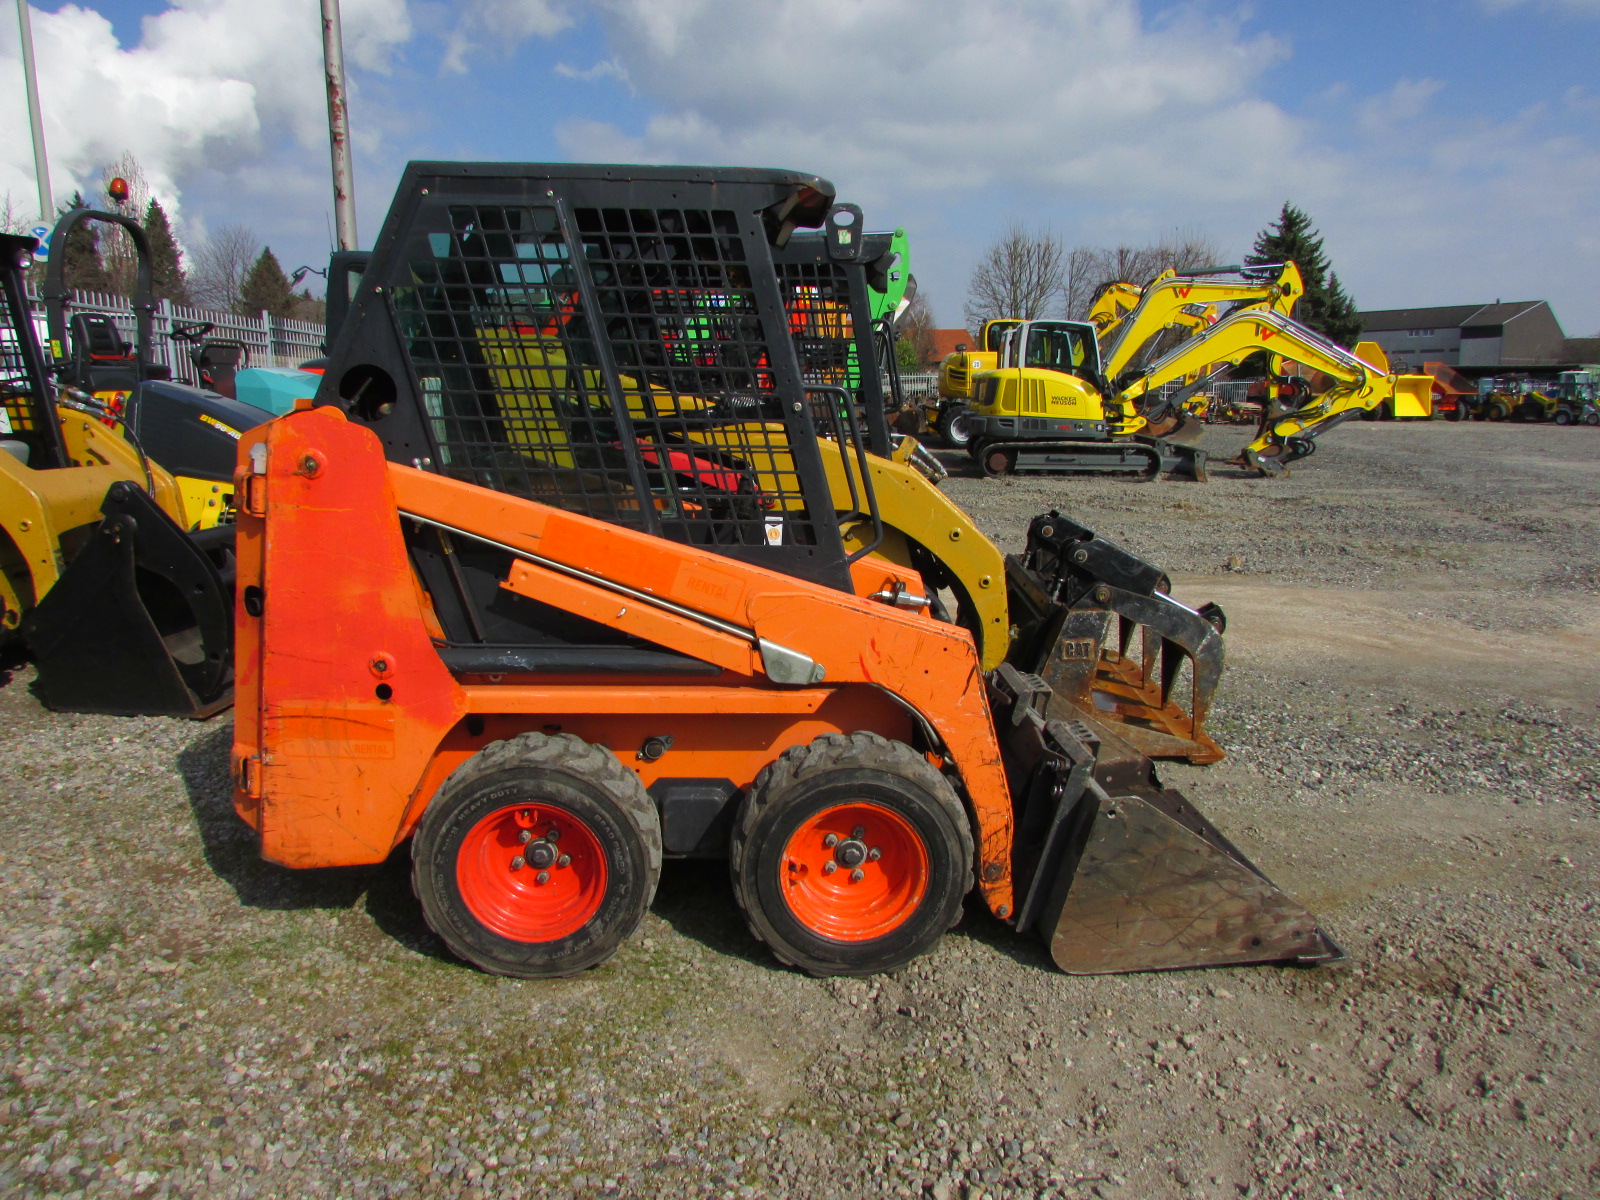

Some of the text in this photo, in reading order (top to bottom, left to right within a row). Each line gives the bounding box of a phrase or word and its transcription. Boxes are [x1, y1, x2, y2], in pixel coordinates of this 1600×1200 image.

[687, 576, 729, 602] RENTAL
[1065, 642, 1091, 657] CAT
[354, 743, 389, 755] RENTAL
[458, 787, 518, 820] HEAVY DUTY
